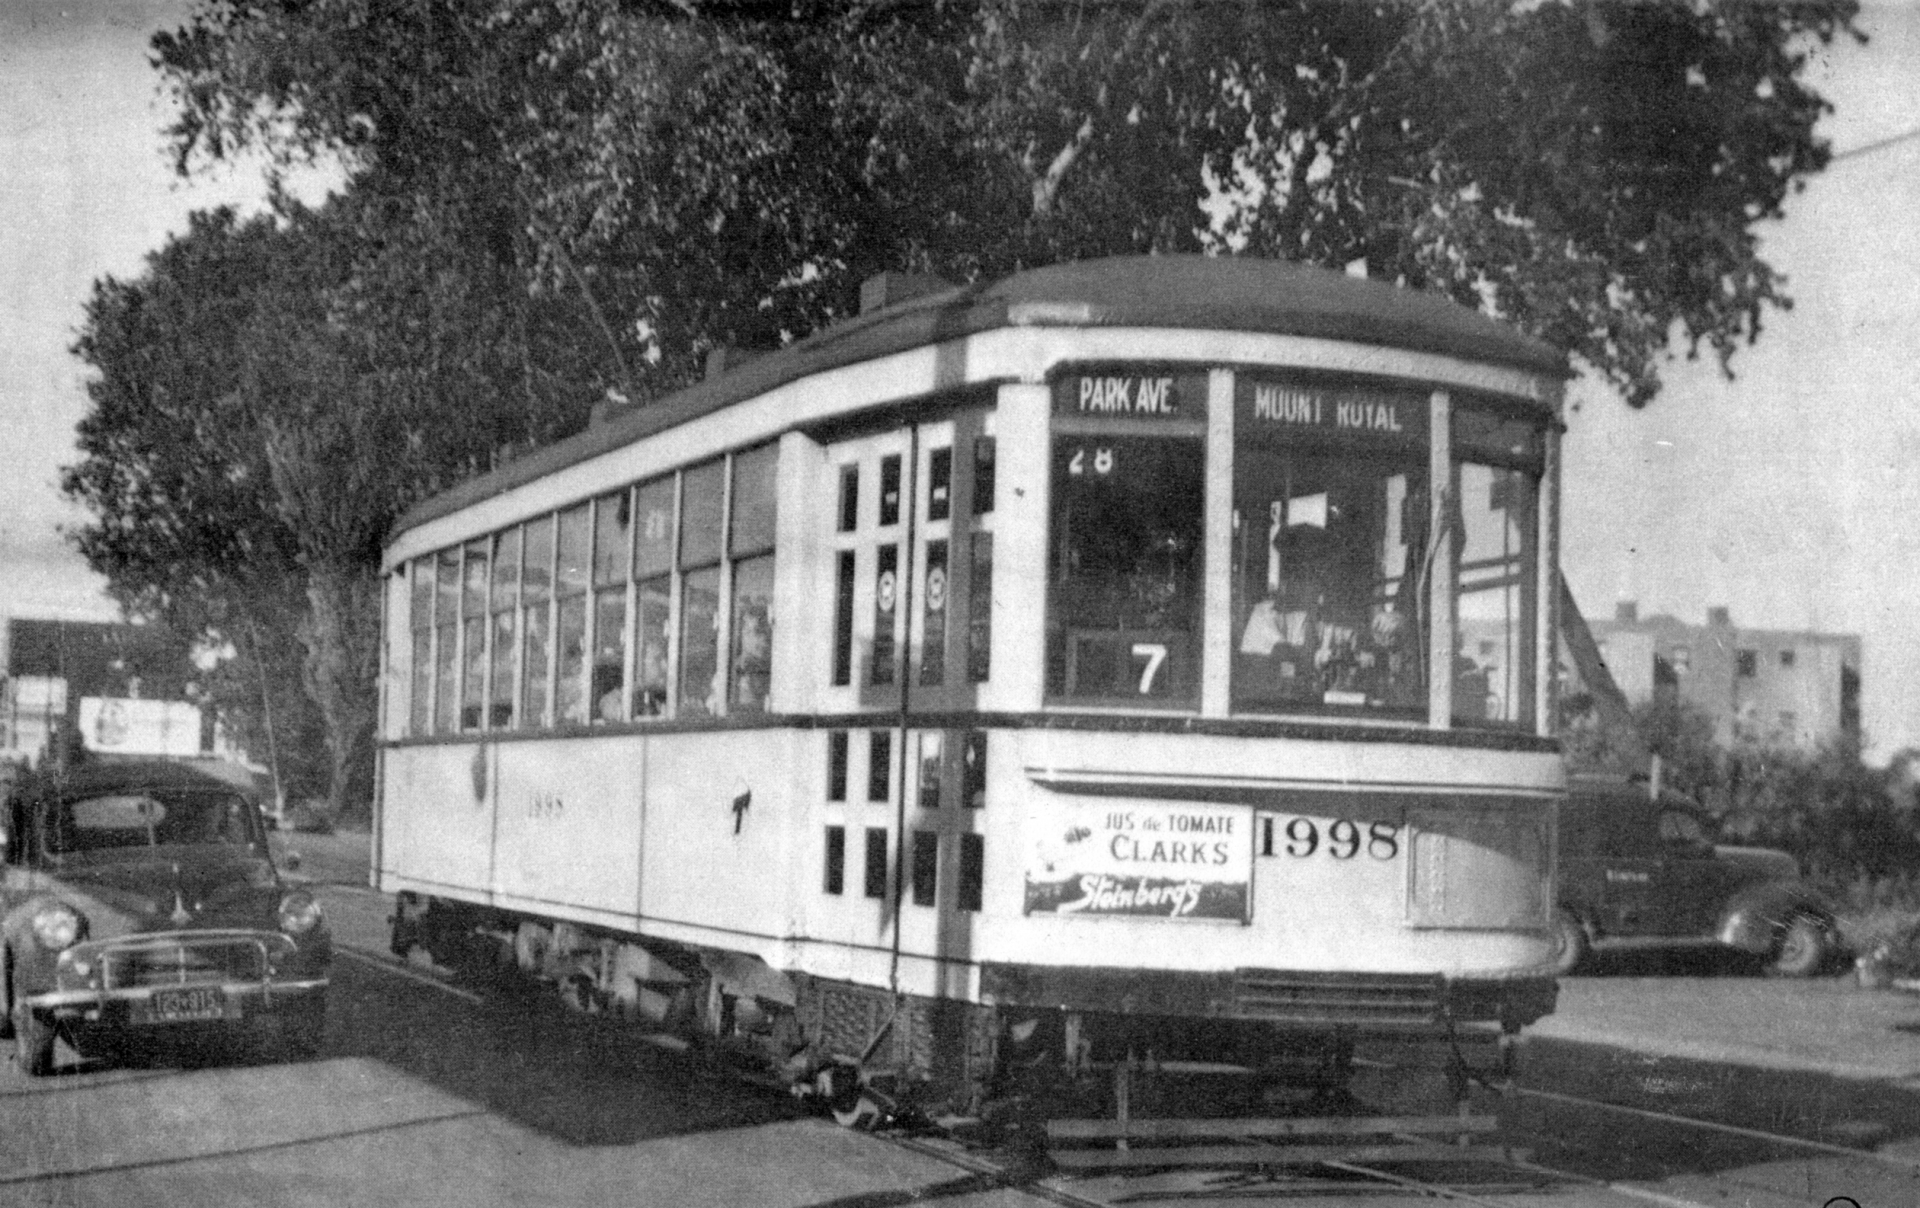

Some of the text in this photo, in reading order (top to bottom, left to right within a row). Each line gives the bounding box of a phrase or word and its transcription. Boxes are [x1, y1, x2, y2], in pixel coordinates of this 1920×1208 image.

[1081, 377, 1131, 411] PARK
[1132, 644, 1167, 693] 7
[1105, 812, 1235, 834] JUS de TOMATE
[1259, 817, 1400, 861] 1998
[1110, 834, 1229, 866] CLARKS
